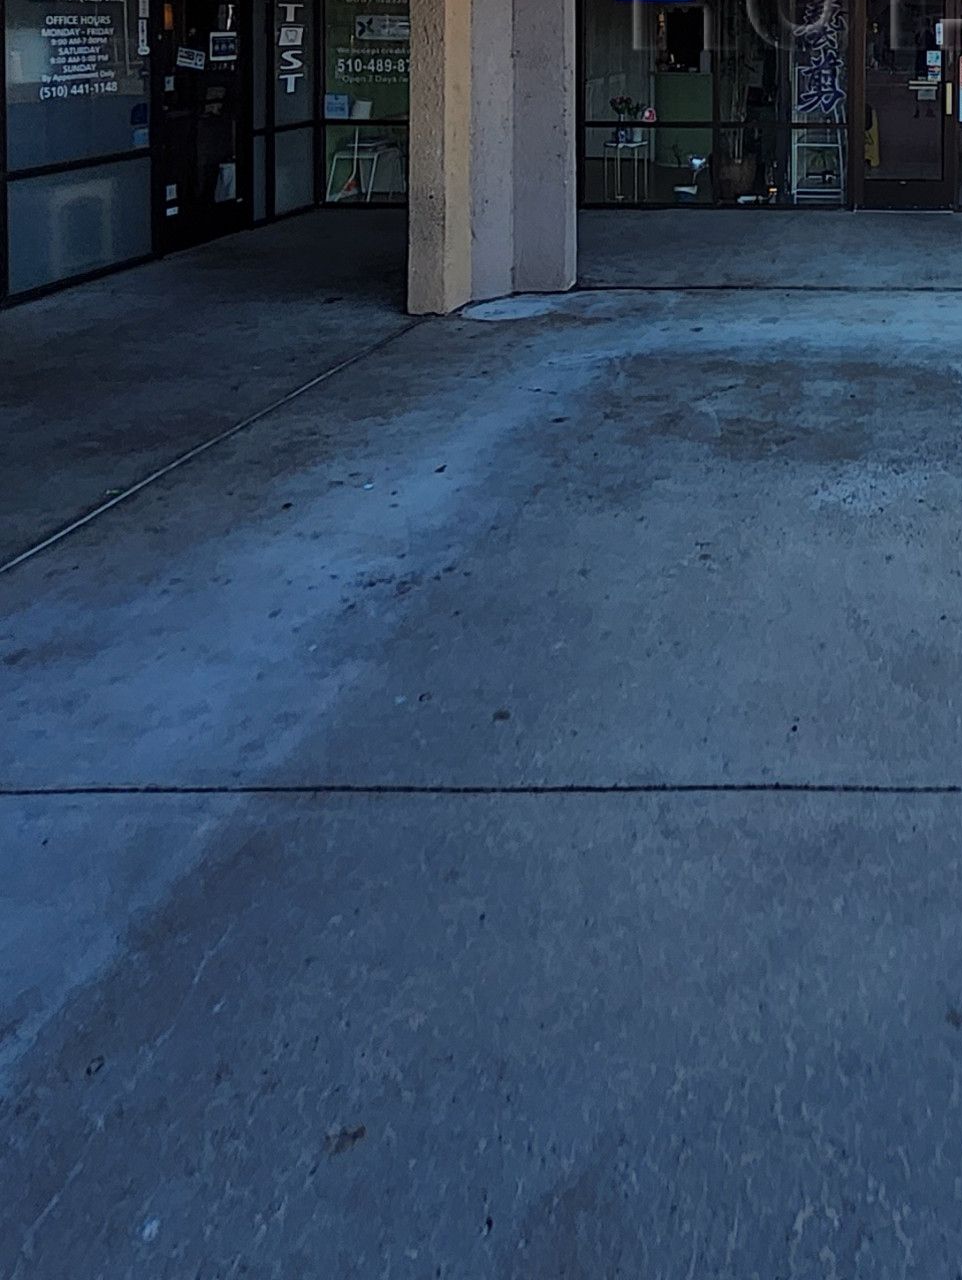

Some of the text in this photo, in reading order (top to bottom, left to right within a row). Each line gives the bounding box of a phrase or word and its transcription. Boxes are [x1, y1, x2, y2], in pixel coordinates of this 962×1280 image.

[46, 15, 111, 25] OFFICE HOURS
[41, 28, 80, 37] MONDAY
[87, 27, 114, 36] FRIDAY
[58, 46, 101, 56] SATURDAY
[62, 64, 97, 74] SUNDAY
[41, 74, 52, 83] By
[342, 75, 367, 84] Open
[375, 76, 397, 84] Days
[39, 81, 118, 100] (510) 441-1148
